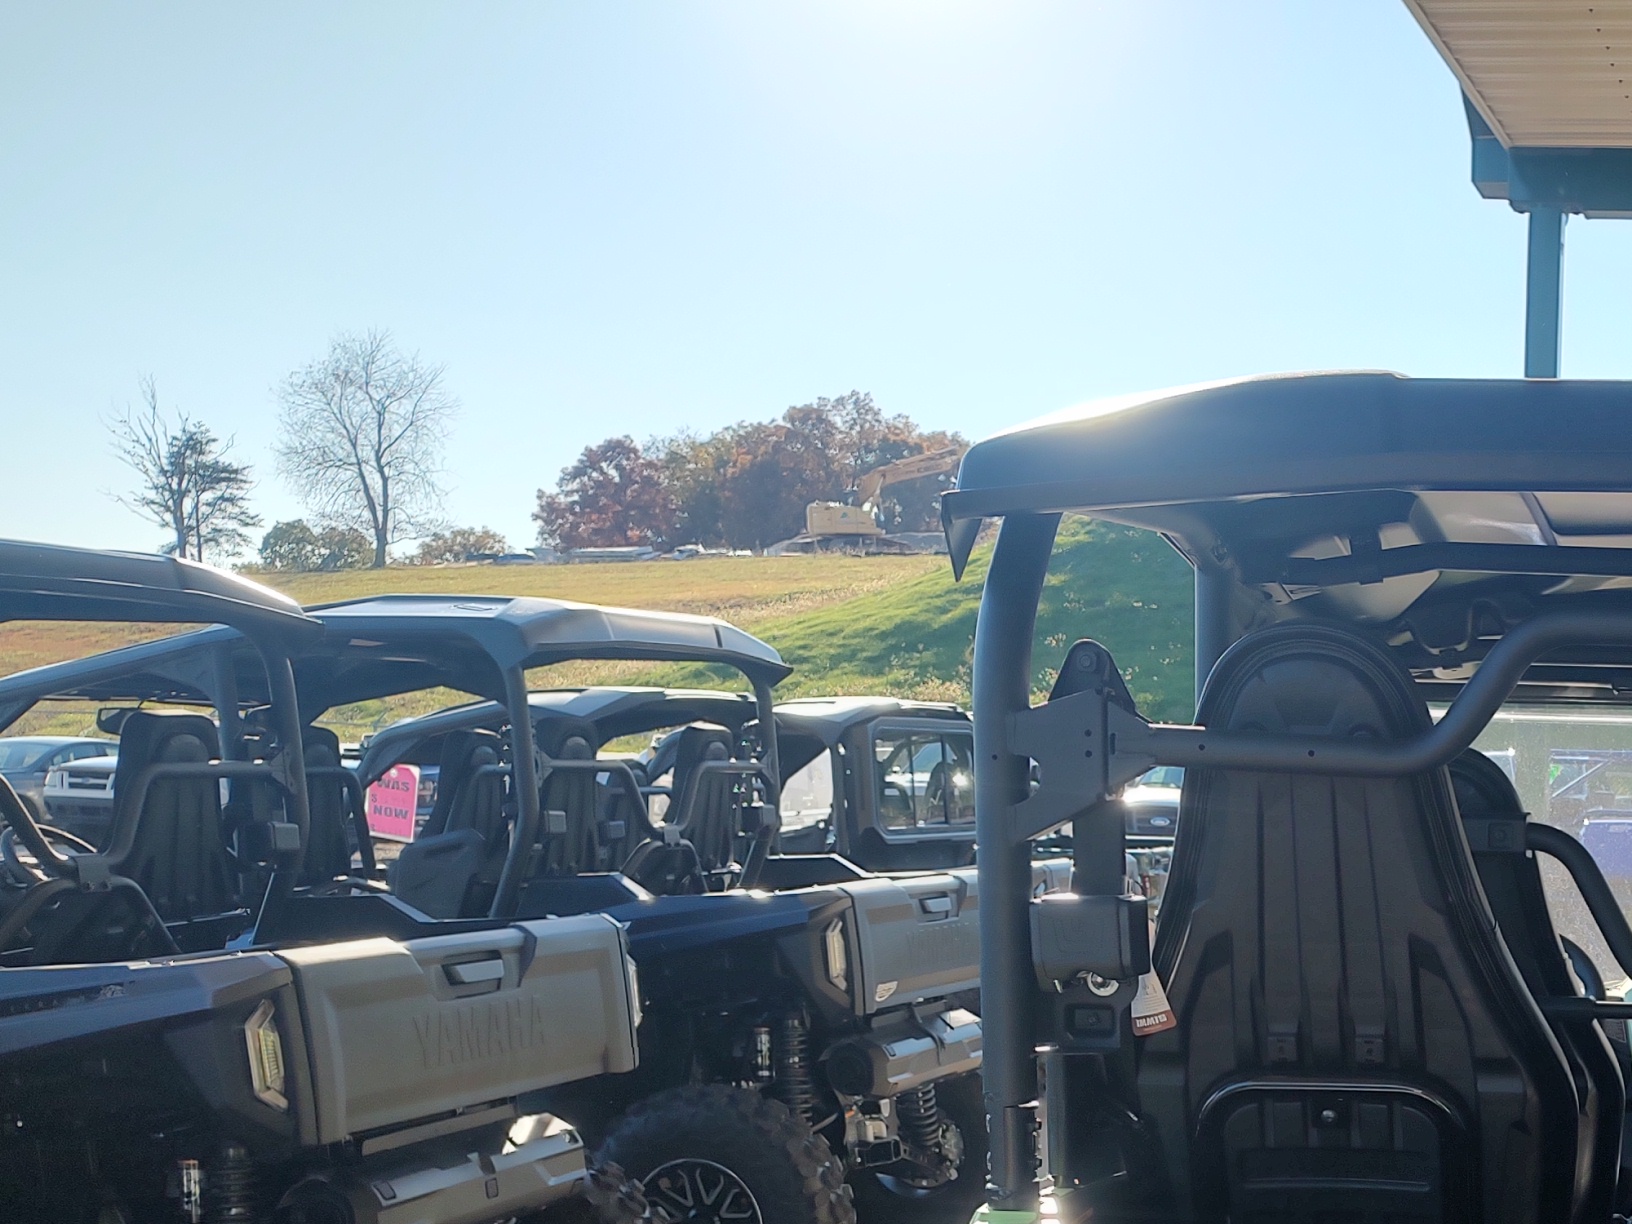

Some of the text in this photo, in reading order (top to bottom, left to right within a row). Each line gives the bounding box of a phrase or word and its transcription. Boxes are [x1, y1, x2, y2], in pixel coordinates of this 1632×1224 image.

[378, 778, 410, 791] WAS
[374, 805, 409, 819] NOW
[412, 994, 545, 1069] YAMAHA
